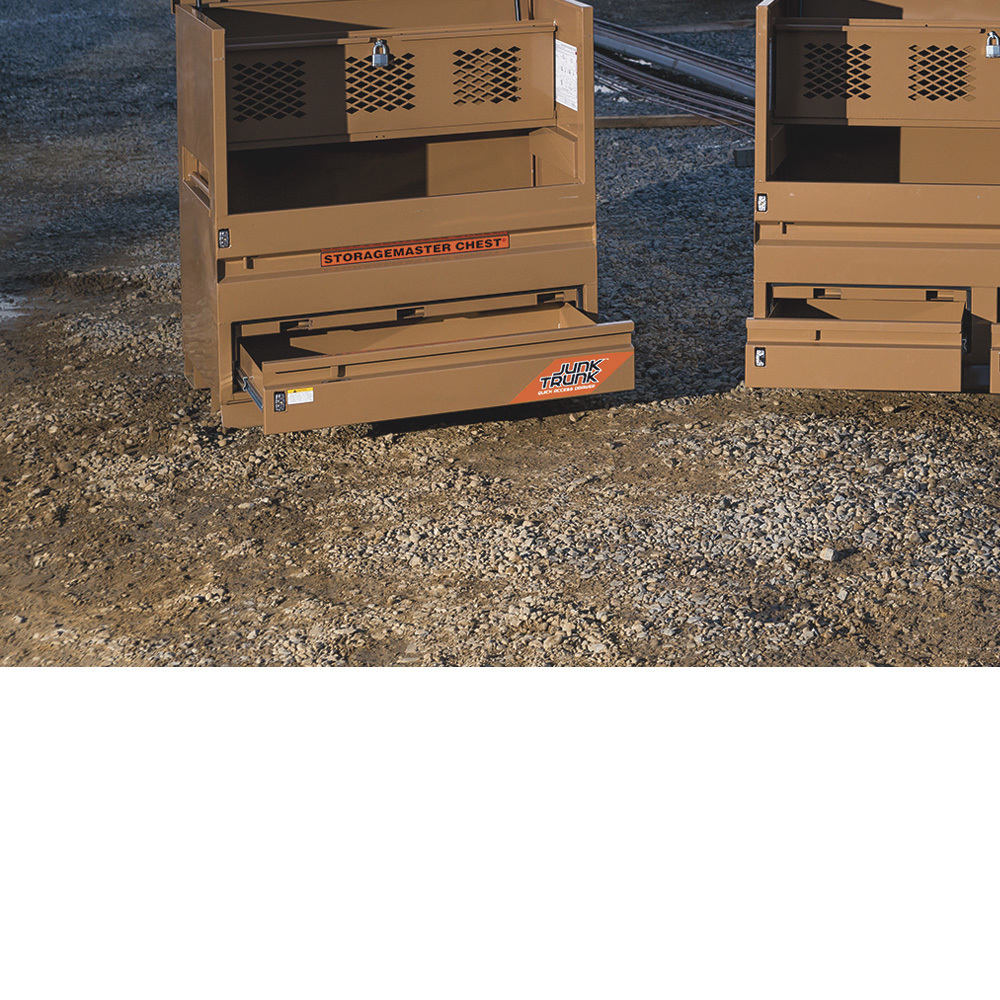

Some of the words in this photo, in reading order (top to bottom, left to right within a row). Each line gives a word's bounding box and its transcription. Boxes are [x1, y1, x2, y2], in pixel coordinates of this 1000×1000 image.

[324, 243, 451, 264] STORAGEMASTER
[552, 359, 604, 376] JUNK
[540, 370, 599, 389] TRUNK
